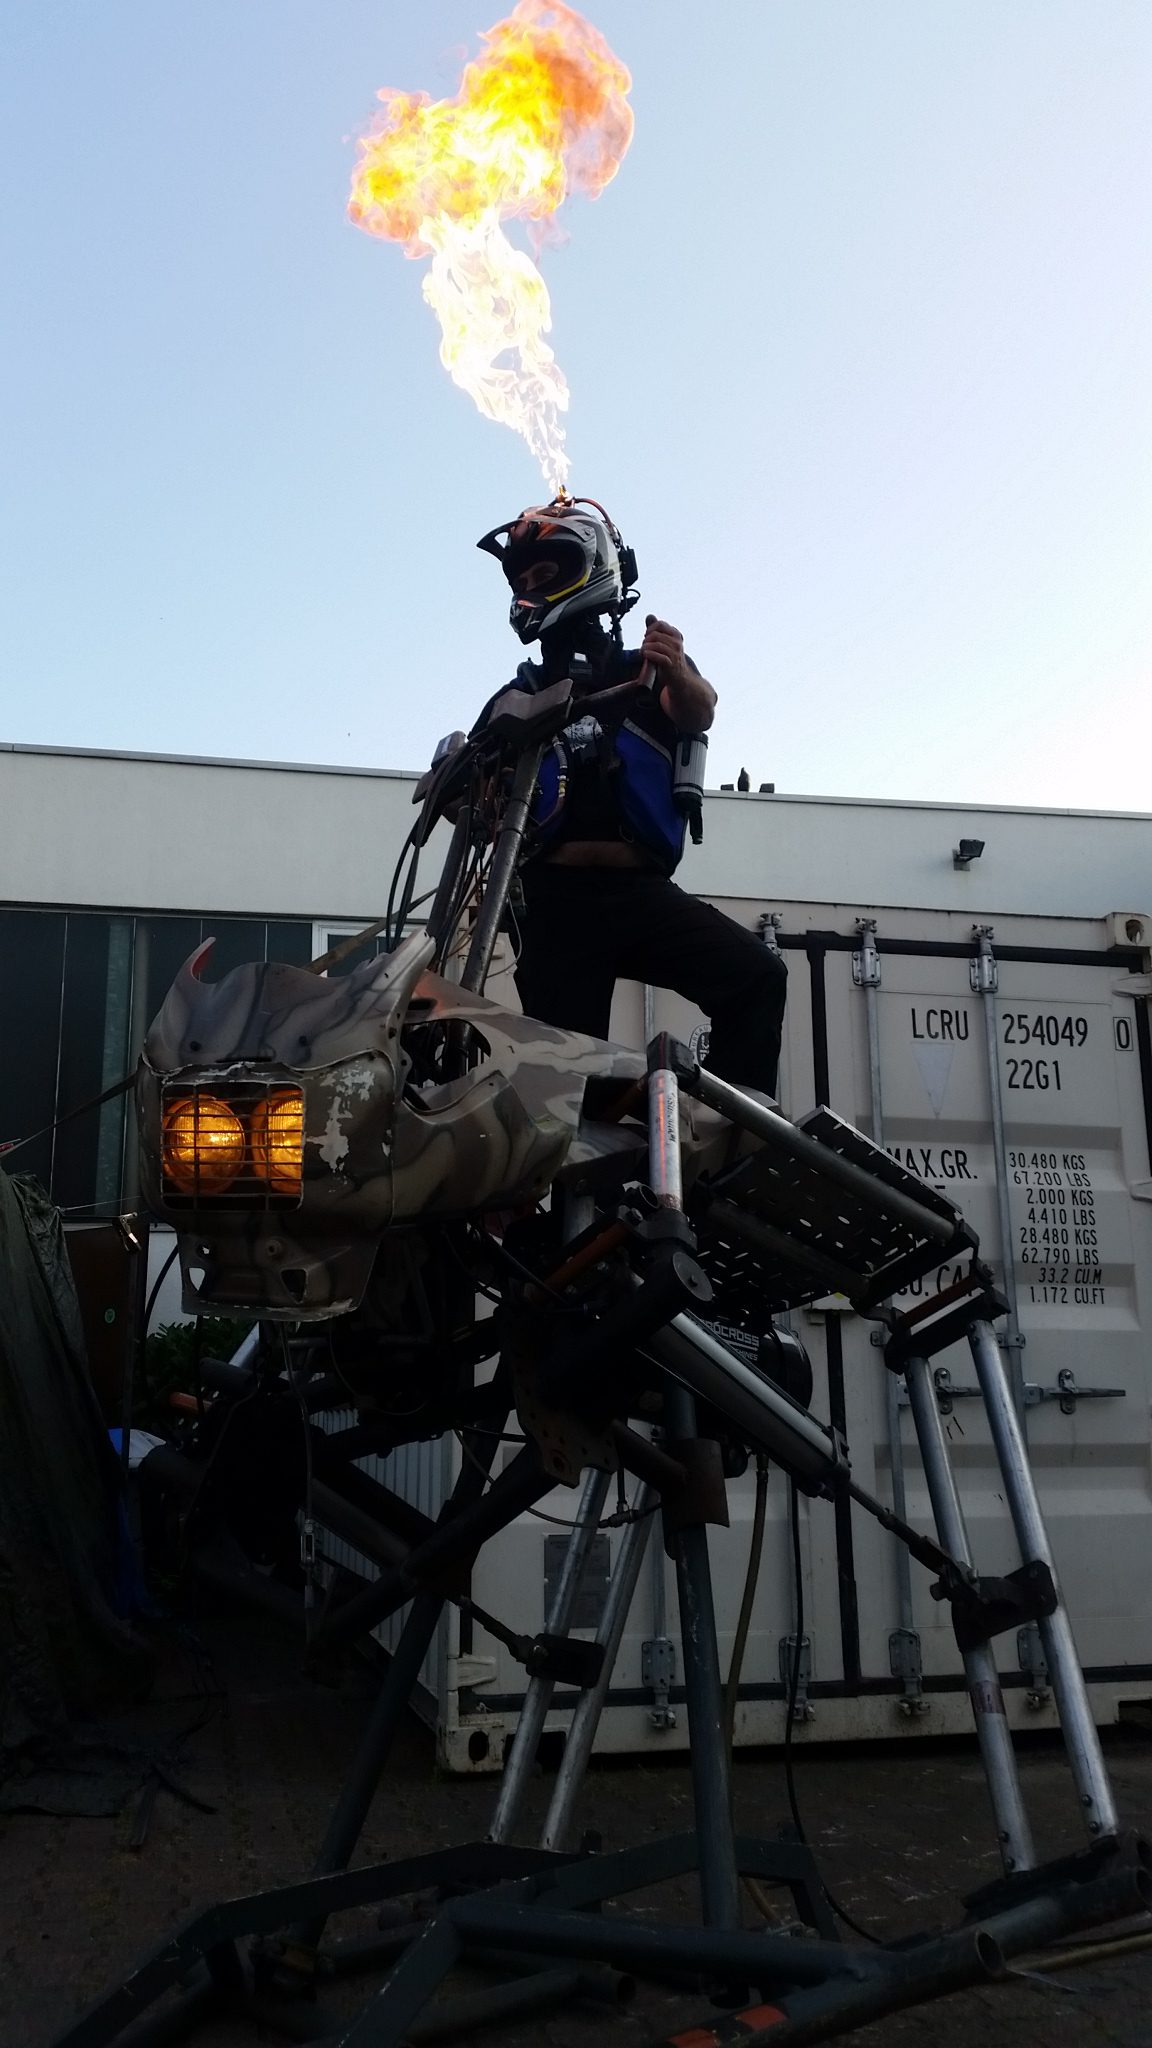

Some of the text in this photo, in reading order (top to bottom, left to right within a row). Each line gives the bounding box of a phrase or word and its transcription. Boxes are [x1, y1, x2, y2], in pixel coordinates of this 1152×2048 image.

[911, 1008, 1130, 1049] LCRU 254049 0
[1006, 1059, 1061, 1090] 22G1
[1009, 1152, 1056, 1169] 30.480
[1063, 1154, 1086, 1170] KGS
[1013, 1171, 1091, 1187] 67.200 LBS
[1026, 1188, 1094, 1206] 2.000 KGS
[1028, 1208, 1096, 1225] 4.410 LBS
[1020, 1227, 1097, 1245] 28.480 KGS
[1021, 1247, 1099, 1266] 62.790 LBS
[1038, 1267, 1068, 1284] 33.2
[1074, 1268, 1102, 1285] CU.M
[1030, 1286, 1105, 1304] 1.172 CU.FT
